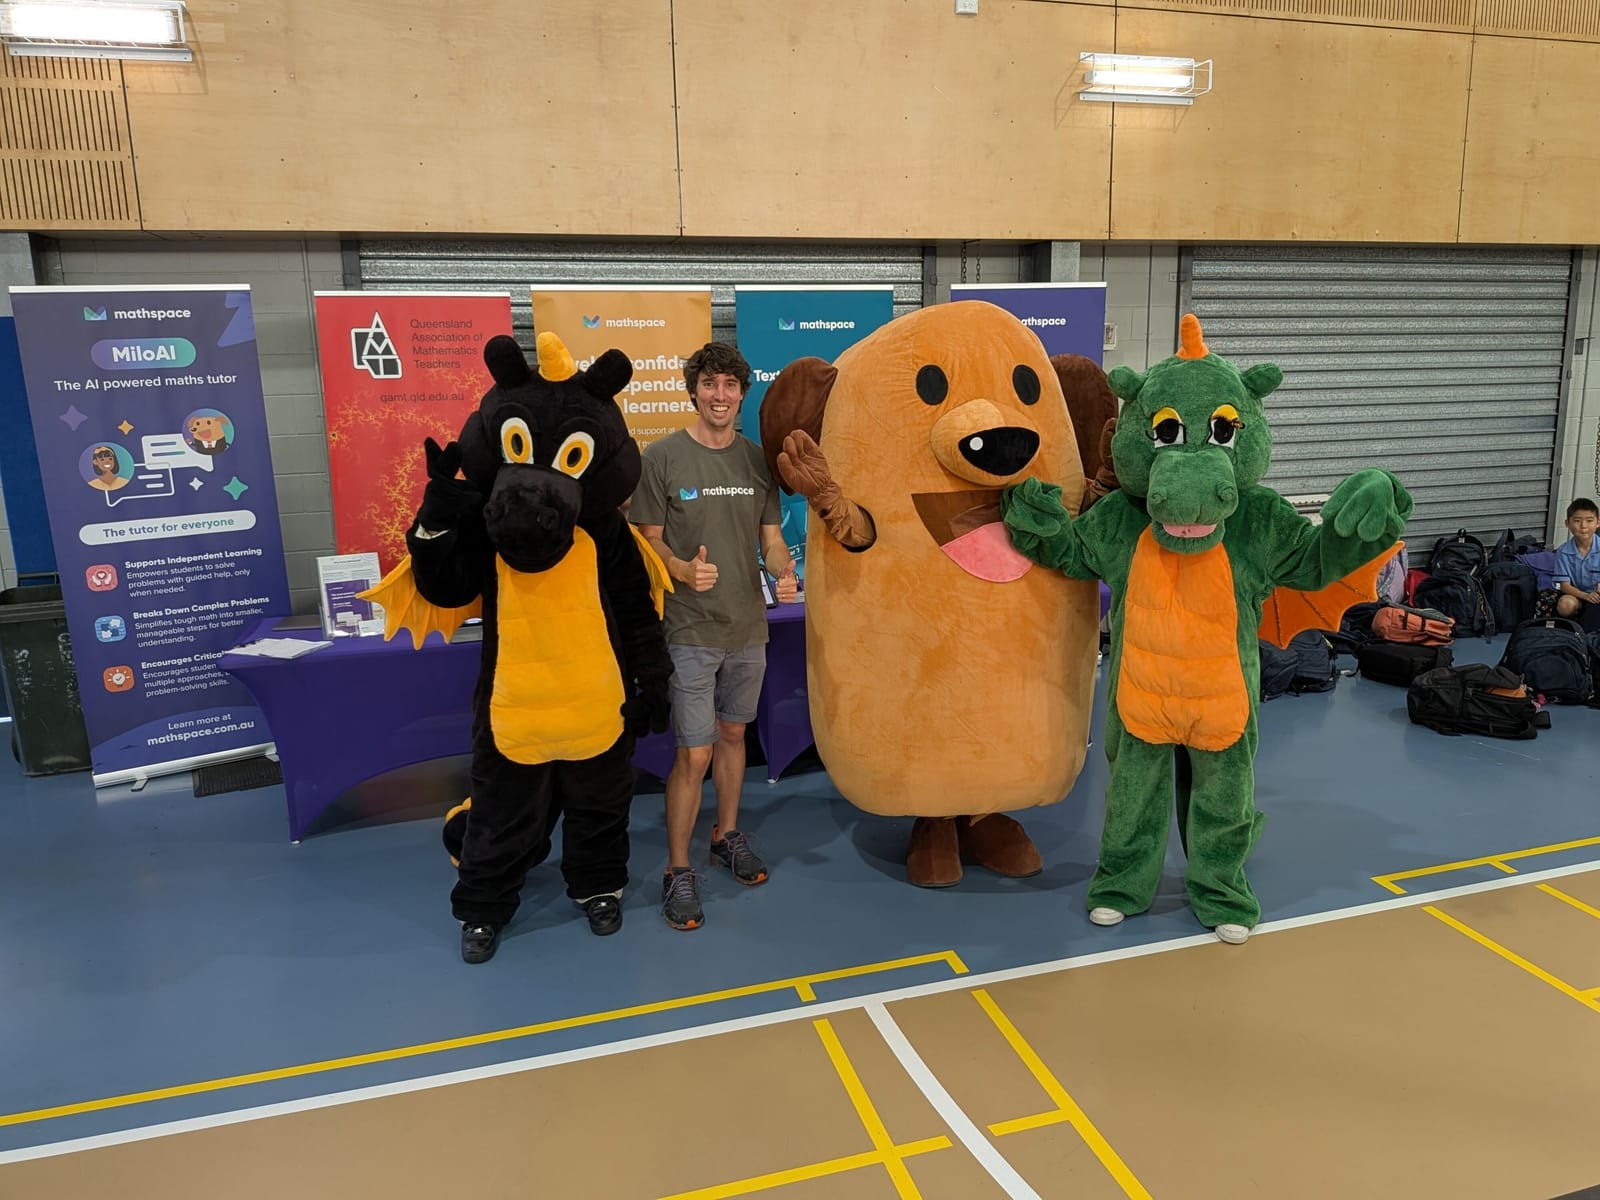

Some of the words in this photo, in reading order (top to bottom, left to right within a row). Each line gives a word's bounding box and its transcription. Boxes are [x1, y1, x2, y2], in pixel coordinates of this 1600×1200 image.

[114, 308, 191, 320] mathspace
[1021, 316, 1066, 328] athspace
[410, 319, 473, 330] Queensland
[606, 317, 666, 329] mathspace
[799, 320, 855, 331] mathspace
[411, 332, 471, 343] Association
[472, 333, 483, 342] of
[112, 345, 176, 363] MiloAI
[412, 346, 478, 356] Mathematics
[414, 359, 461, 369] Teachers
[54, 380, 81, 391] The
[85, 379, 99, 390] AI
[103, 376, 161, 391] powered
[165, 375, 204, 386] maths
[207, 374, 238, 384] tutor
[380, 391, 464, 403] qamt.qld.edu.au
[623, 398, 696, 414] learners
[702, 485, 755, 497] mathspace
[102, 528, 126, 538] The
[129, 525, 159, 535] tutor
[161, 523, 178, 533] for
[181, 517, 235, 531] everyone
[125, 558, 166, 569] Supports
[167, 551, 223, 565] Independent
[225, 547, 263, 559] Learning
[126, 569, 168, 580] Empowers
[170, 564, 204, 575] students
[205, 563, 213, 571] to
[214, 561, 235, 570] solve
[128, 578, 165, 589] problems
[167, 575, 184, 584] with
[185, 571, 212, 583] guided
[234, 568, 251, 578] only
[129, 589, 152, 598] when
[153, 585, 187, 595] needed.
[133, 609, 163, 620] Breaks
[165, 605, 190, 616] Down
[191, 601, 229, 614] Complex
[230, 596, 270, 608] Problems
[135, 618, 172, 631] Simplifies
[174, 615, 197, 627] tough
[198, 613, 217, 623] math
[219, 611, 233, 620] into
[235, 607, 264, 617] smaller,
[136, 626, 185, 639] manageable
[187, 623, 208, 633] steps
[209, 620, 219, 629] for
[221, 618, 244, 628] better
[137, 634, 196, 648] understanding.
[141, 656, 192, 670] Encourages
[142, 667, 189, 679] Encourages
[190, 663, 217, 673] studen
[144, 677, 175, 689] multiple
[177, 671, 224, 685] approaches,
[146, 682, 208, 698] problem-solving
[168, 720, 195, 731] Learn
[196, 717, 221, 727] more
[222, 713, 232, 722] at
[147, 720, 255, 746] mathspace.com.au
